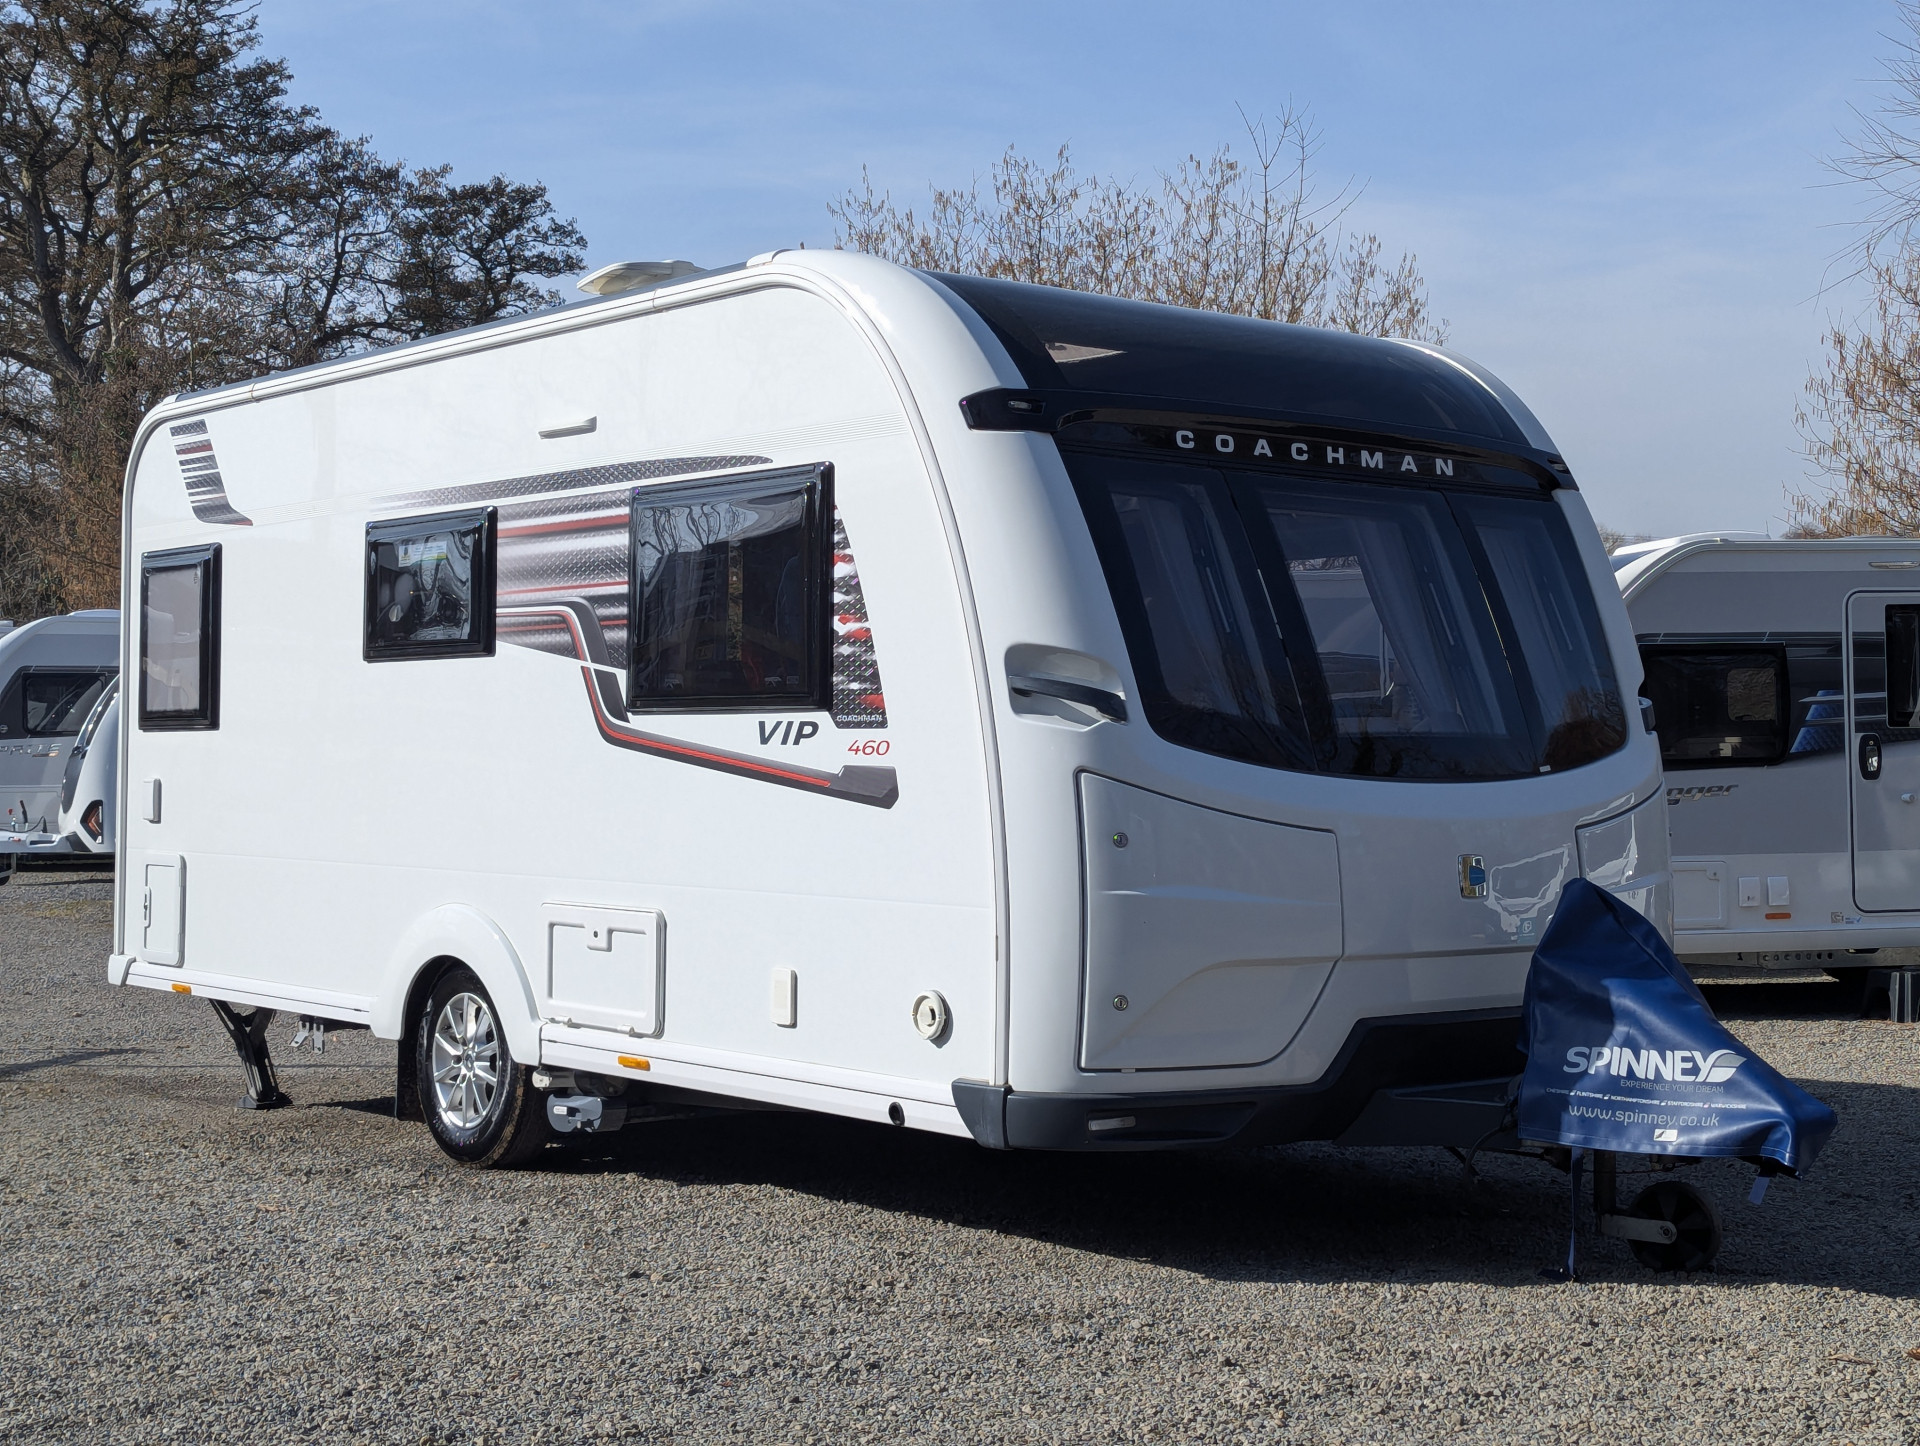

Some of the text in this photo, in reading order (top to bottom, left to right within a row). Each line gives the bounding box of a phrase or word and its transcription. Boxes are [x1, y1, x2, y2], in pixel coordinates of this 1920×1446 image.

[1175, 430, 1454, 476] COACHMAN
[836, 714, 884, 723] COACHMAN
[758, 720, 891, 756] VIP 460
[1563, 1046, 1738, 1083] SPINNEY
[1620, 1079, 1724, 1094] EXPERIENCE YOUR DREAM
[1568, 1104, 1720, 1128] www.spinney.co.uk
